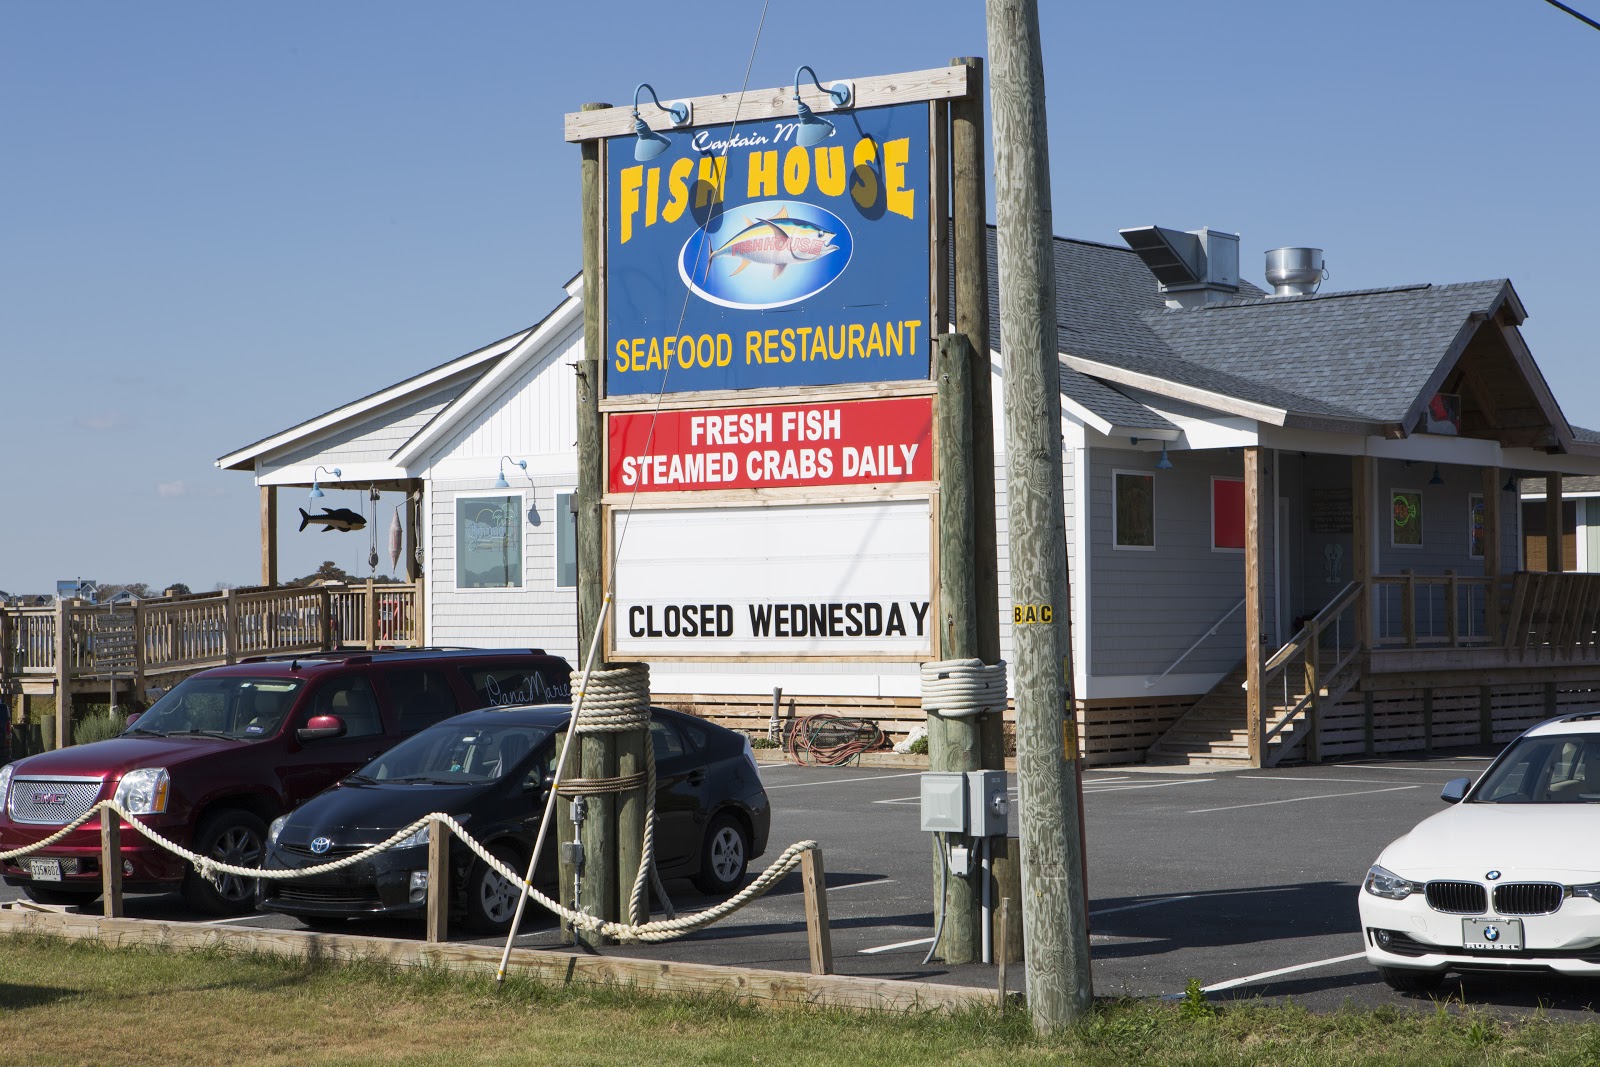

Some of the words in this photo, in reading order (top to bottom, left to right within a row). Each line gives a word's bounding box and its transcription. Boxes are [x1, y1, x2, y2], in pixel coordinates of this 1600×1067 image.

[691, 130, 769, 156] Captain
[620, 156, 728, 244] FISH
[747, 137, 914, 220] HOUSE
[615, 333, 733, 373] SEAFOOD
[746, 319, 921, 365] RESTAURANT
[691, 415, 773, 446] FRESH
[782, 409, 841, 442] FISH
[622, 452, 739, 486] STEAMED
[746, 448, 834, 481] CRABS
[842, 444, 919, 476] DAILY
[629, 605, 734, 638] CLOSED
[749, 602, 930, 637] WEDNESDAY
[1014, 605, 1051, 623] BAC
[32, 793, 65, 804] GMC
